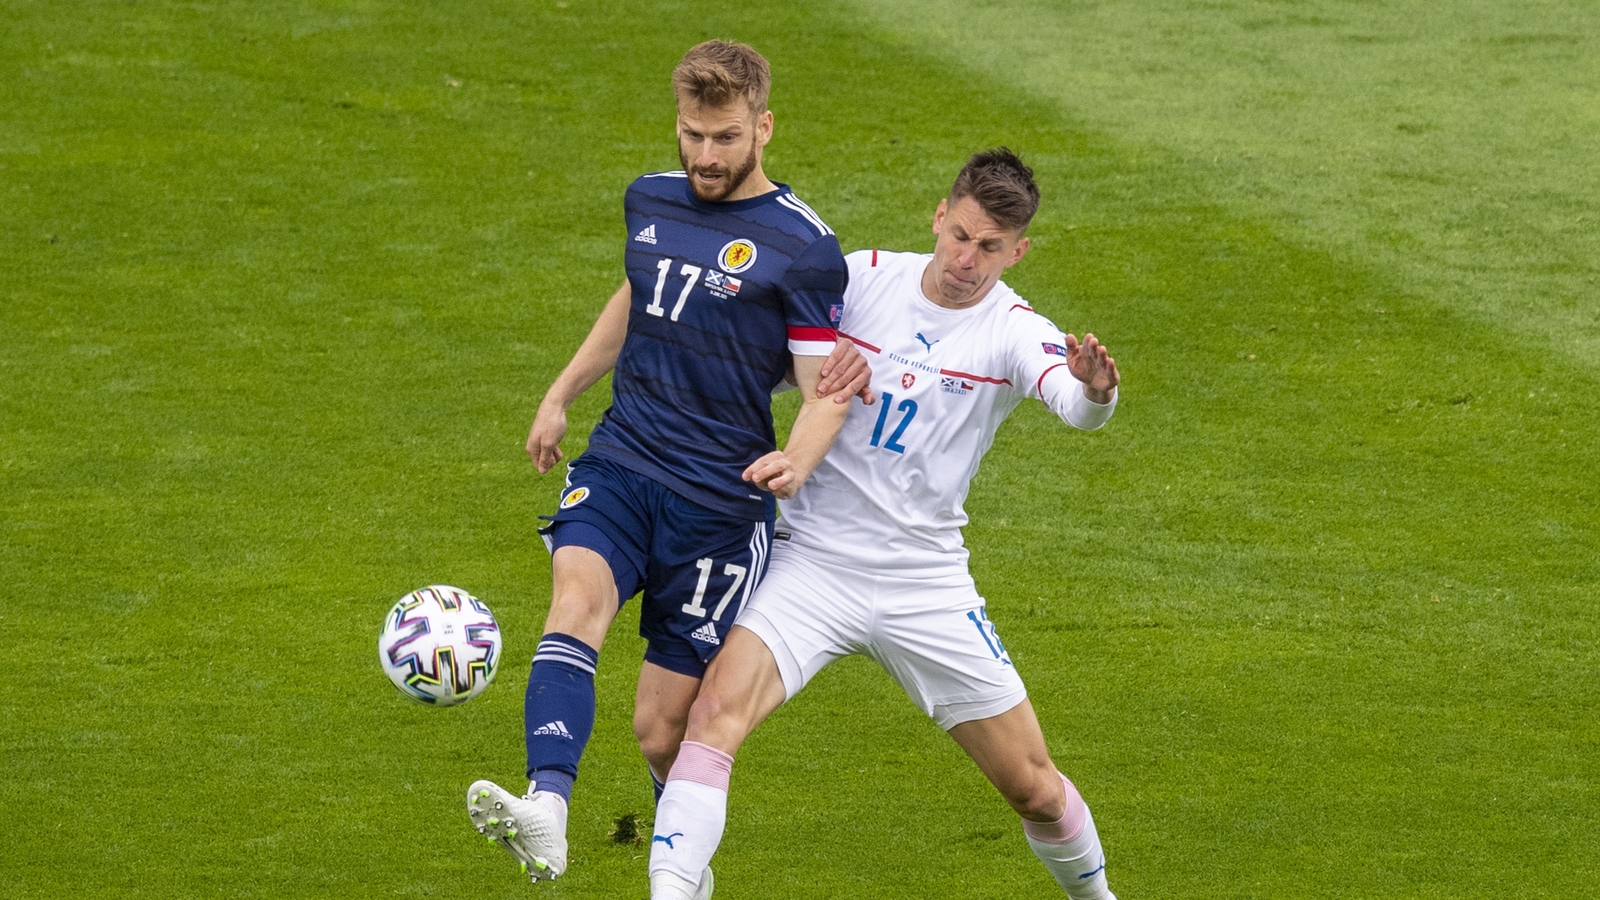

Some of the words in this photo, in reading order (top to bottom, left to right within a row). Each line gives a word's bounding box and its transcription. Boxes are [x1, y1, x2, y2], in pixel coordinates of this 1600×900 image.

[634, 235, 658, 245] adidas
[646, 258, 702, 322] 17
[888, 352, 909, 365] CZECH
[870, 391, 918, 454] 12
[681, 557, 747, 621] 17
[691, 631, 720, 645] adidas
[533, 729, 574, 740] adidas
